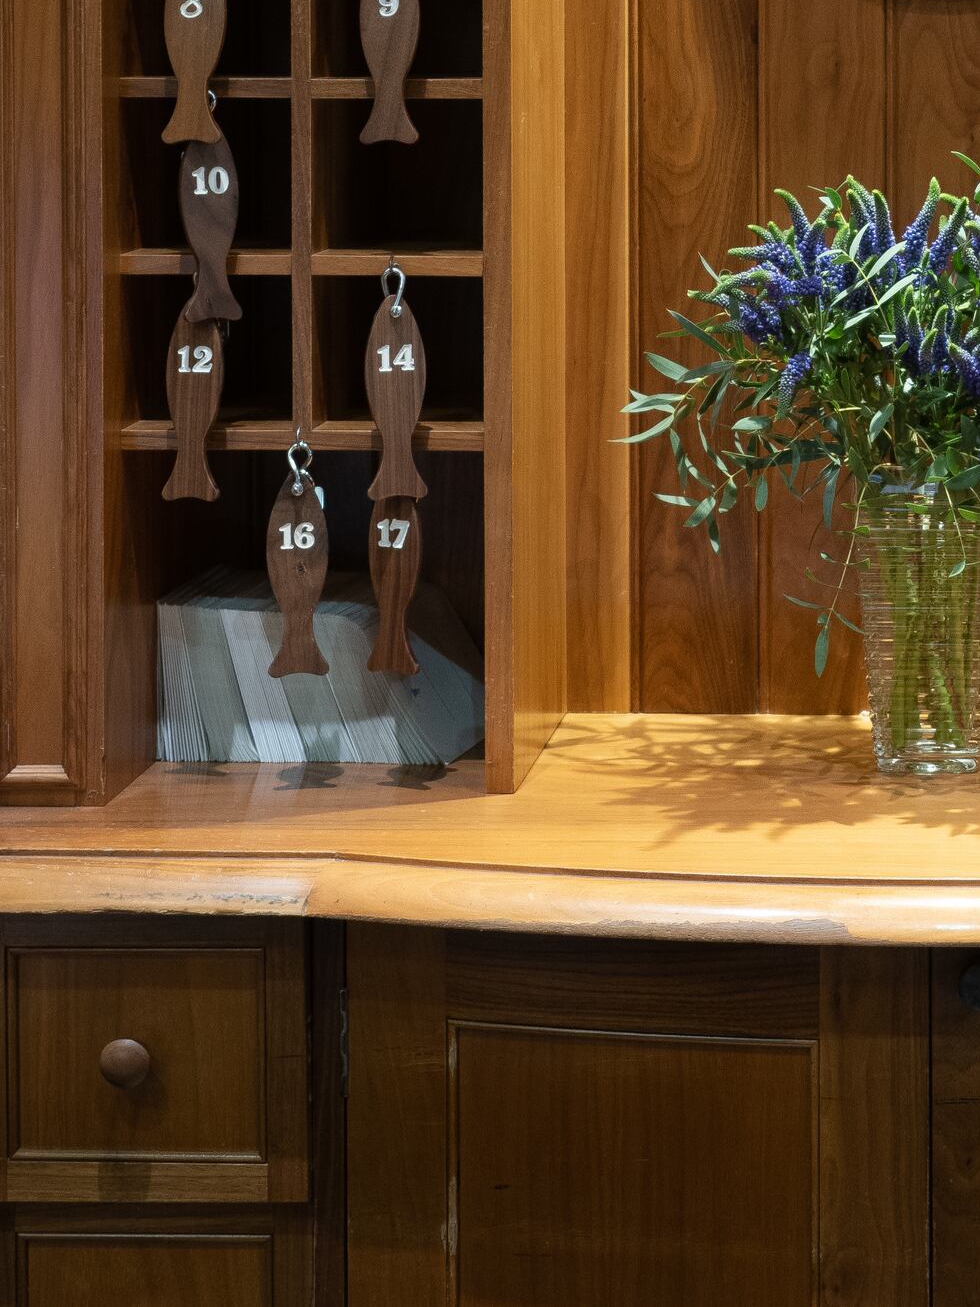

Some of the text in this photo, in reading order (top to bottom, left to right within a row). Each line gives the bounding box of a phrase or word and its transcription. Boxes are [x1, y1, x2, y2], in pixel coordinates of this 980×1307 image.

[191, 166, 230, 196] 10
[177, 345, 213, 374] 12
[376, 343, 416, 373] 14
[278, 521, 316, 550] 16
[376, 518, 411, 550] 17
